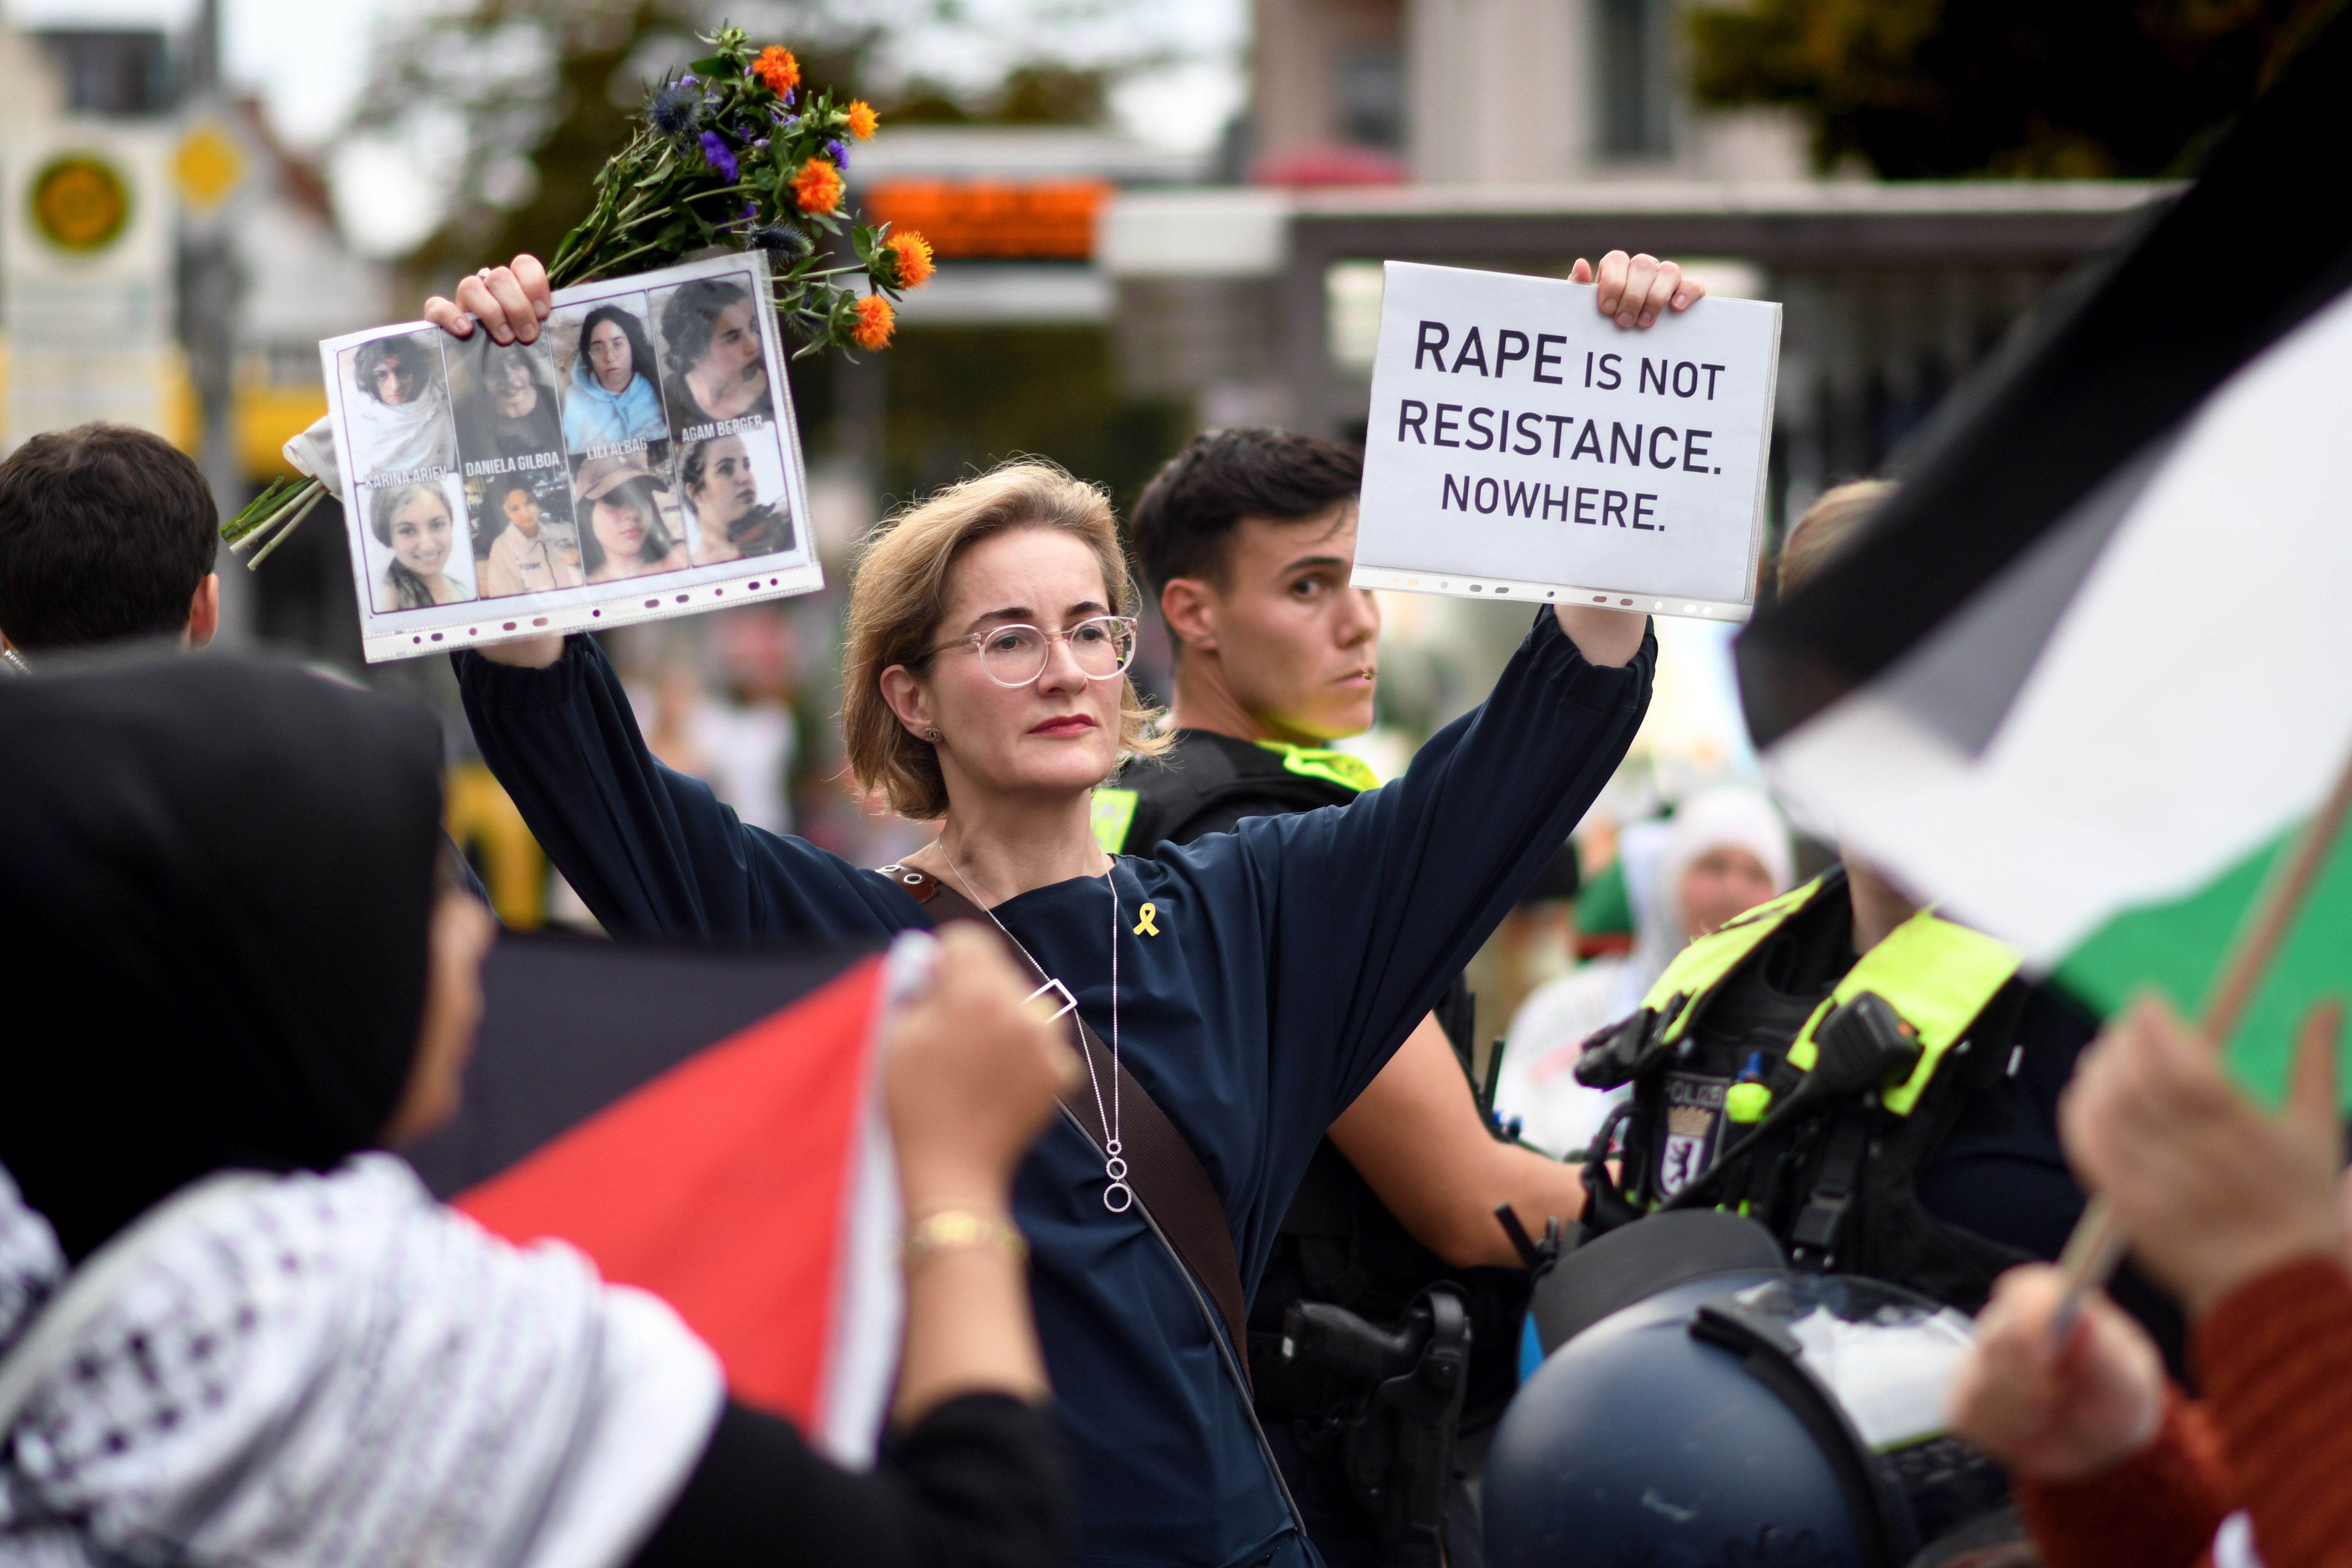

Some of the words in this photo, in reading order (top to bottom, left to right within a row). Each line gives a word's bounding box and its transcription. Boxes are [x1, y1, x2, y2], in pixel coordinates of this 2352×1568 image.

[1415, 321, 1567, 384] RAPE
[1585, 352, 1622, 390] IS
[1639, 358, 1725, 400] NOT
[682, 422, 715, 443] AGAM
[717, 415, 762, 436] BERGER
[1399, 400, 1720, 474] RESISTANCE.
[587, 444, 607, 460] LILI
[610, 437, 648, 457] ALBAG
[365, 471, 410, 489] KARINA
[413, 466, 447, 483] ARIEV
[466, 456, 516, 476] DANIELA
[517, 451, 560, 470] GILBOA
[1442, 474, 1664, 531] NOWHERE.
